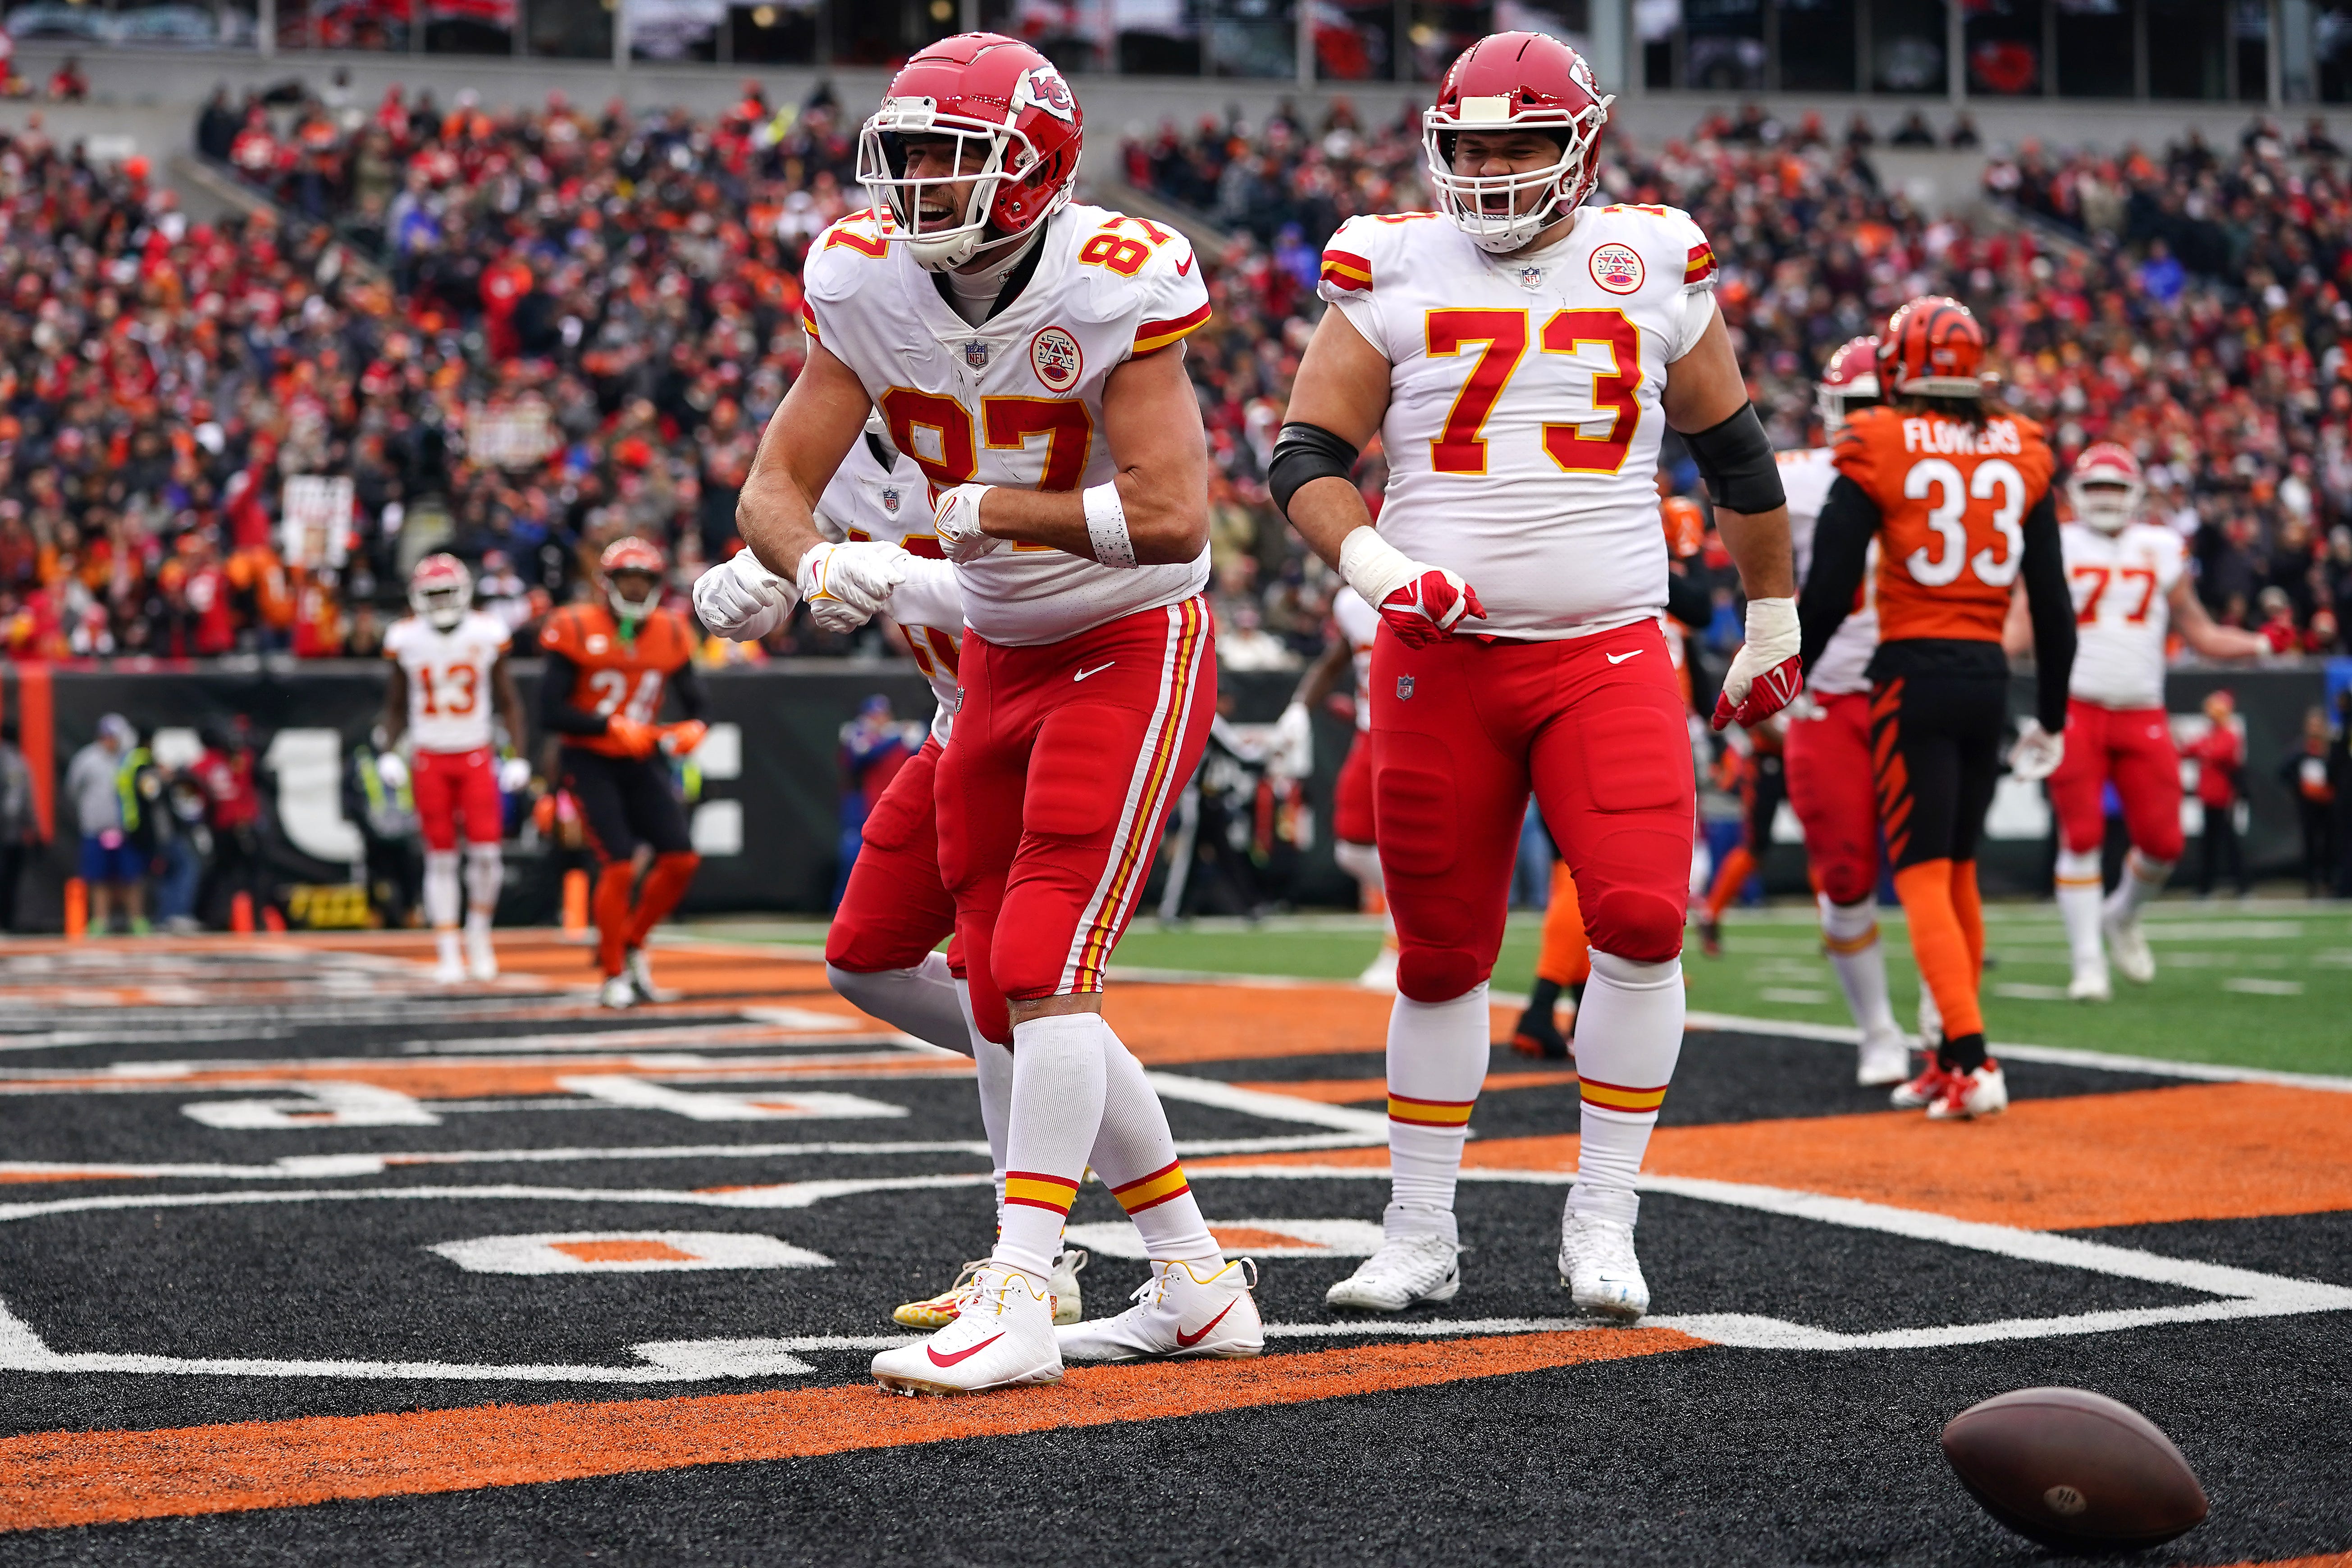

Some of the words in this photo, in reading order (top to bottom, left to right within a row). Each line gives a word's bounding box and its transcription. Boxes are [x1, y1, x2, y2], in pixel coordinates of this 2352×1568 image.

[1078, 217, 1175, 278] 87
[1525, 275, 1539, 285] NFL
[968, 353, 985, 364] NFL
[1425, 307, 1644, 475] 73
[886, 499, 897, 509] NFL
[1904, 457, 2026, 586] 33
[2072, 566, 2156, 625] 77
[421, 664, 477, 714] 13
